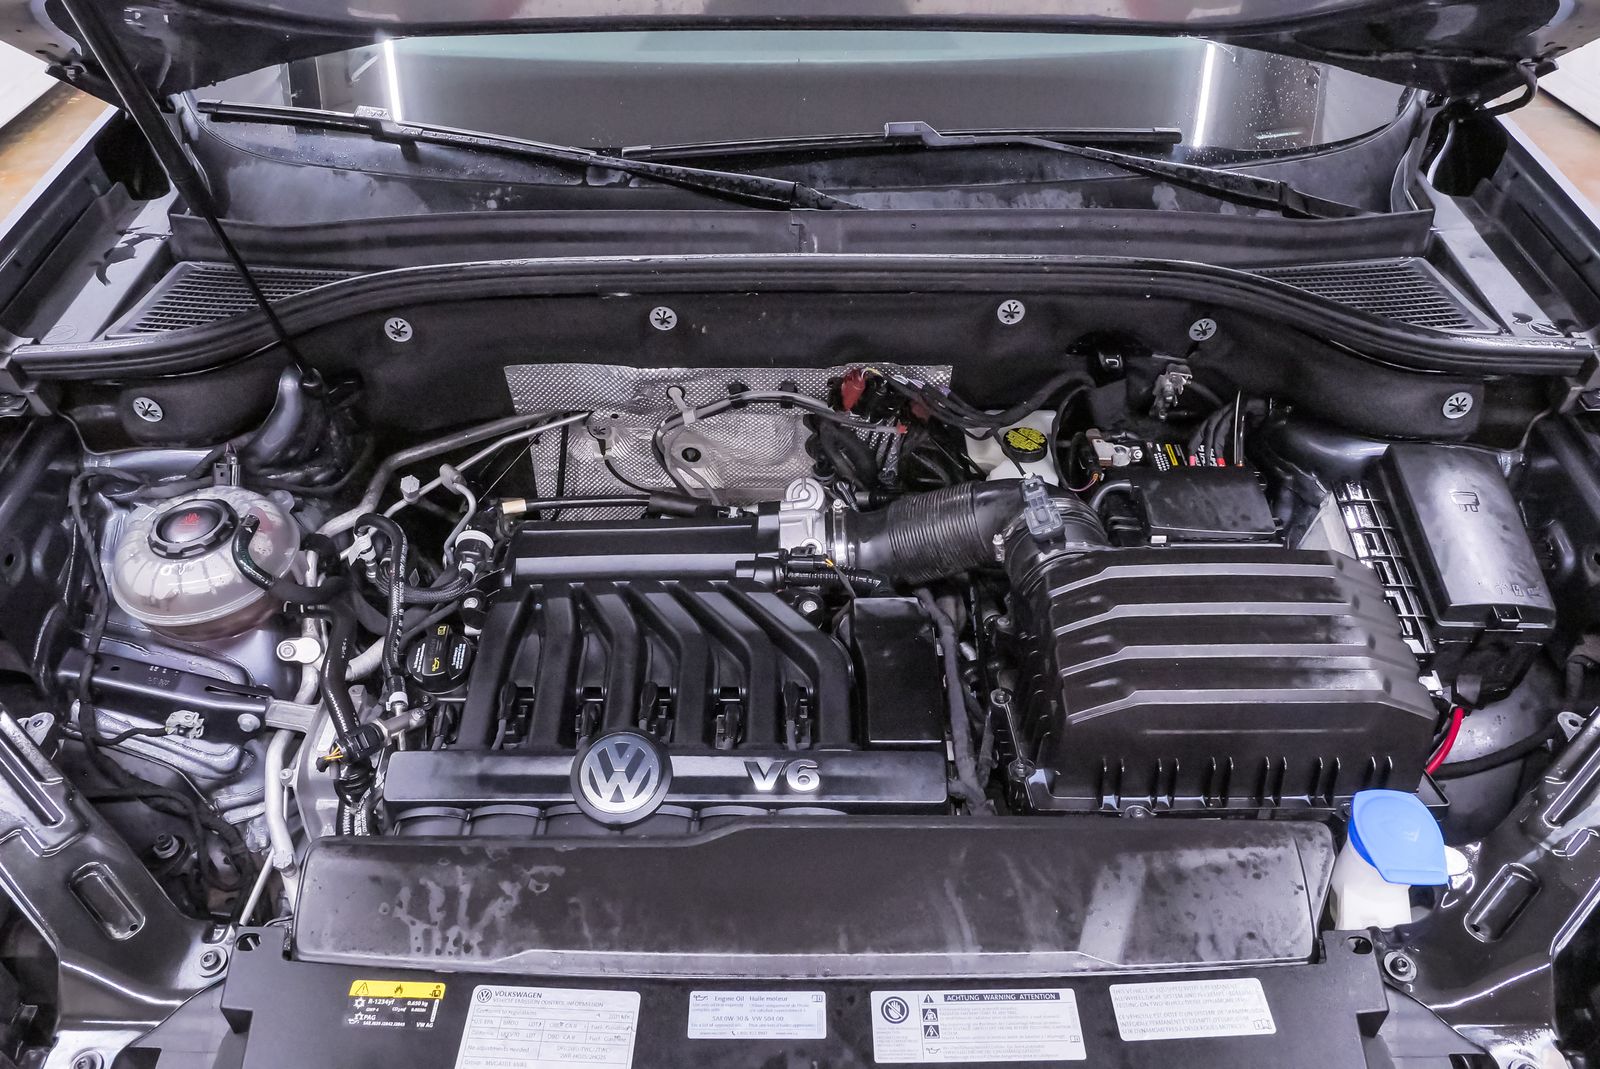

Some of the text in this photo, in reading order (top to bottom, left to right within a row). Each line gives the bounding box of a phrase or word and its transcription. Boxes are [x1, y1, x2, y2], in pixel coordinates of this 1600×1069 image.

[743, 758, 821, 793] V6
[494, 990, 543, 999] VOLKSWAGEN
[367, 998, 396, 1007] R-1234yf
